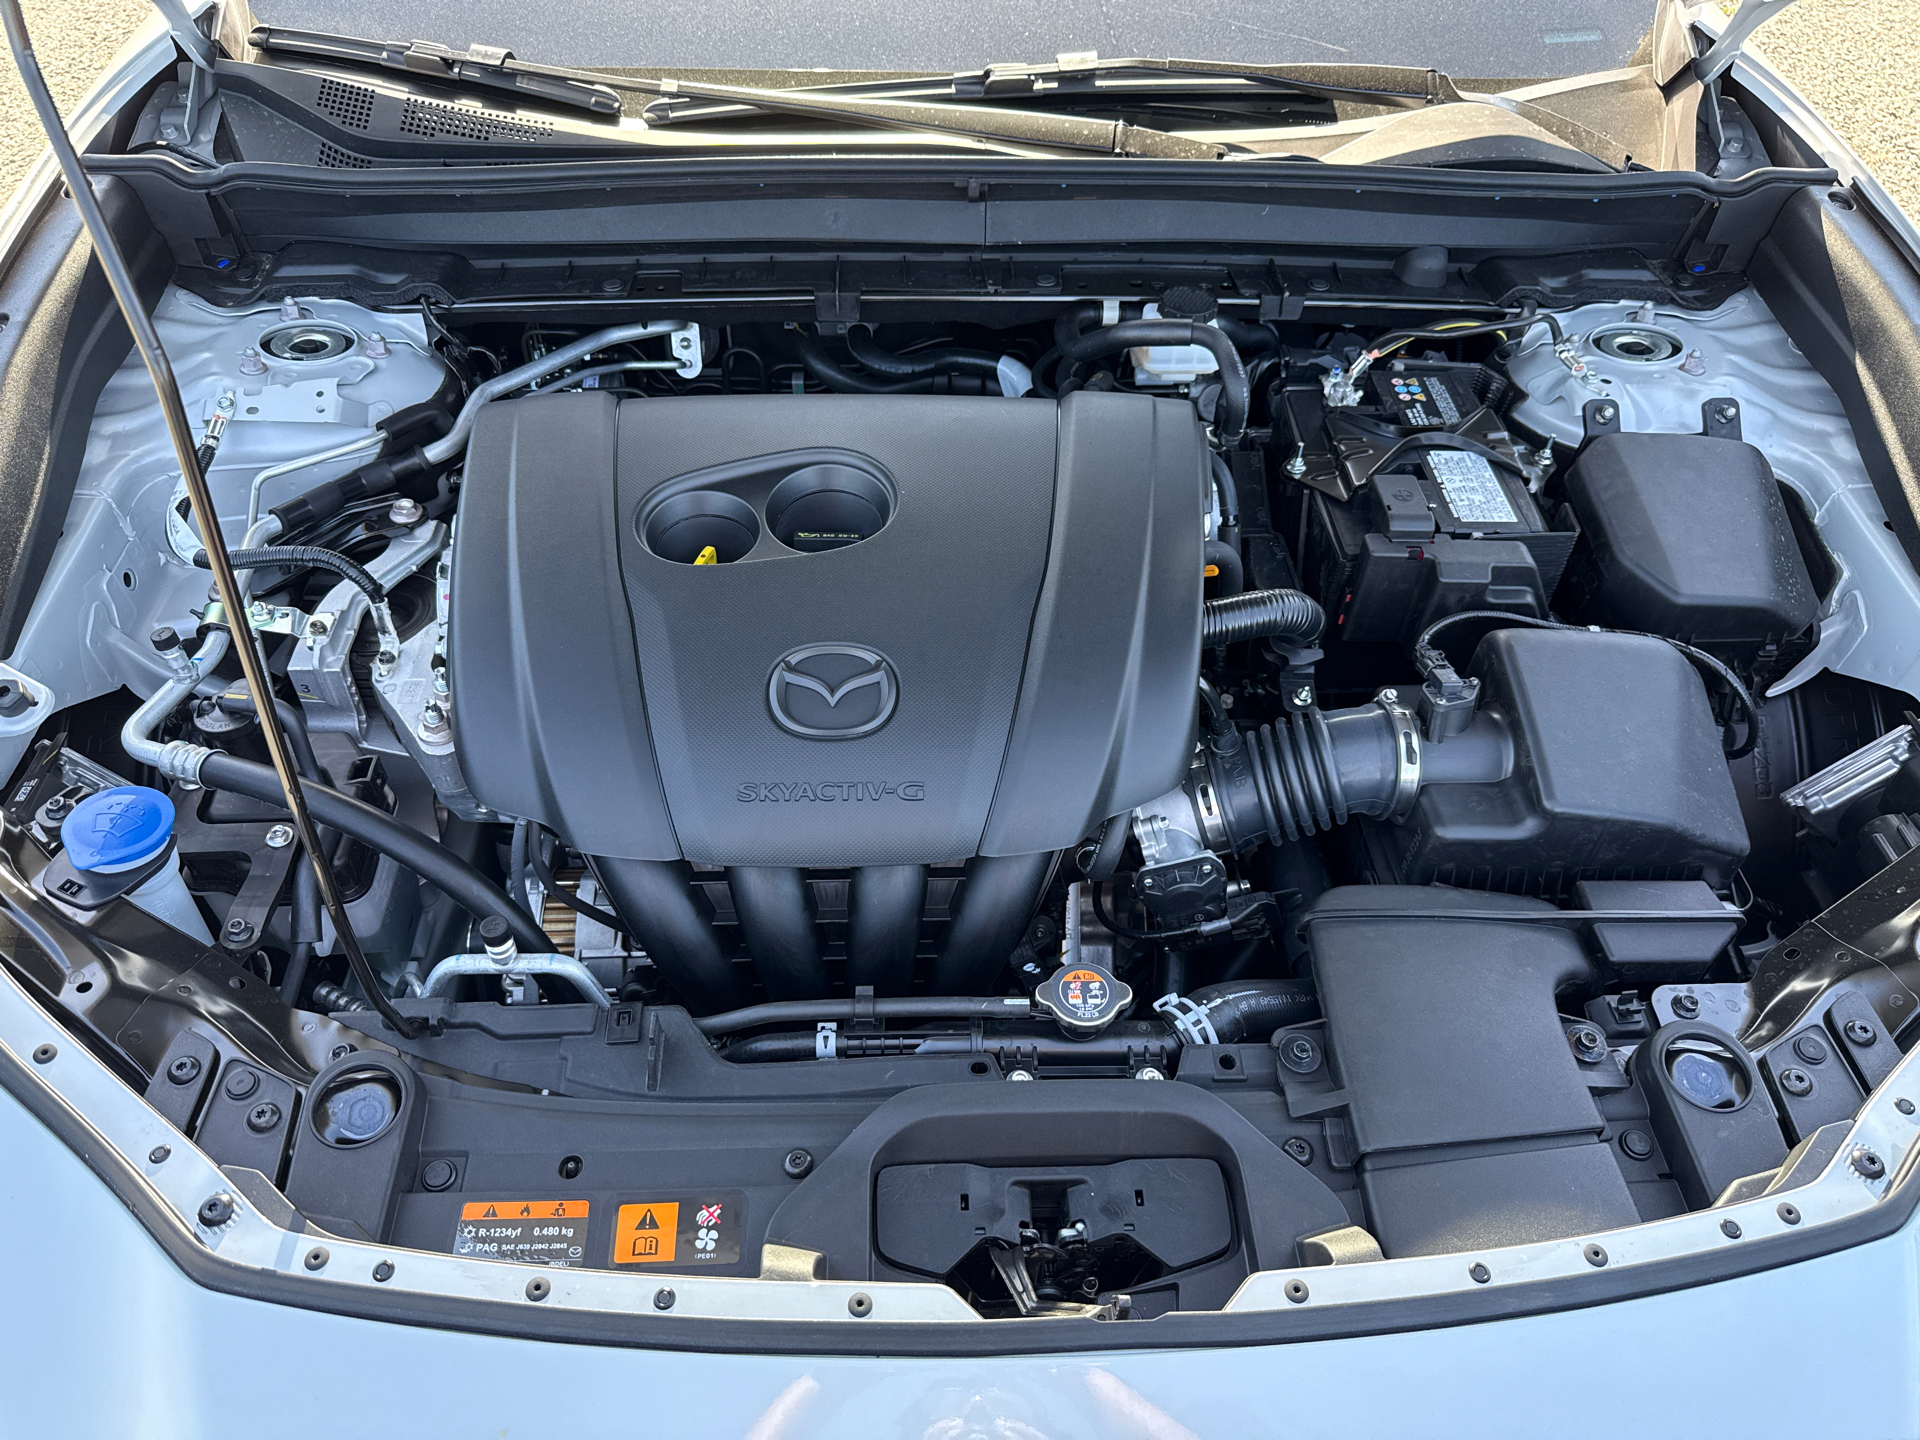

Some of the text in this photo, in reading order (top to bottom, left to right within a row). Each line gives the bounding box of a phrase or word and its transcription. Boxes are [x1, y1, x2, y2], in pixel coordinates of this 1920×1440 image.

[300, 684, 311, 693] 3
[737, 781, 925, 802] SKYACTIV-G
[478, 1226, 574, 1238] R-1234yf 0.480 kg
[476, 1243, 499, 1252] PAG
